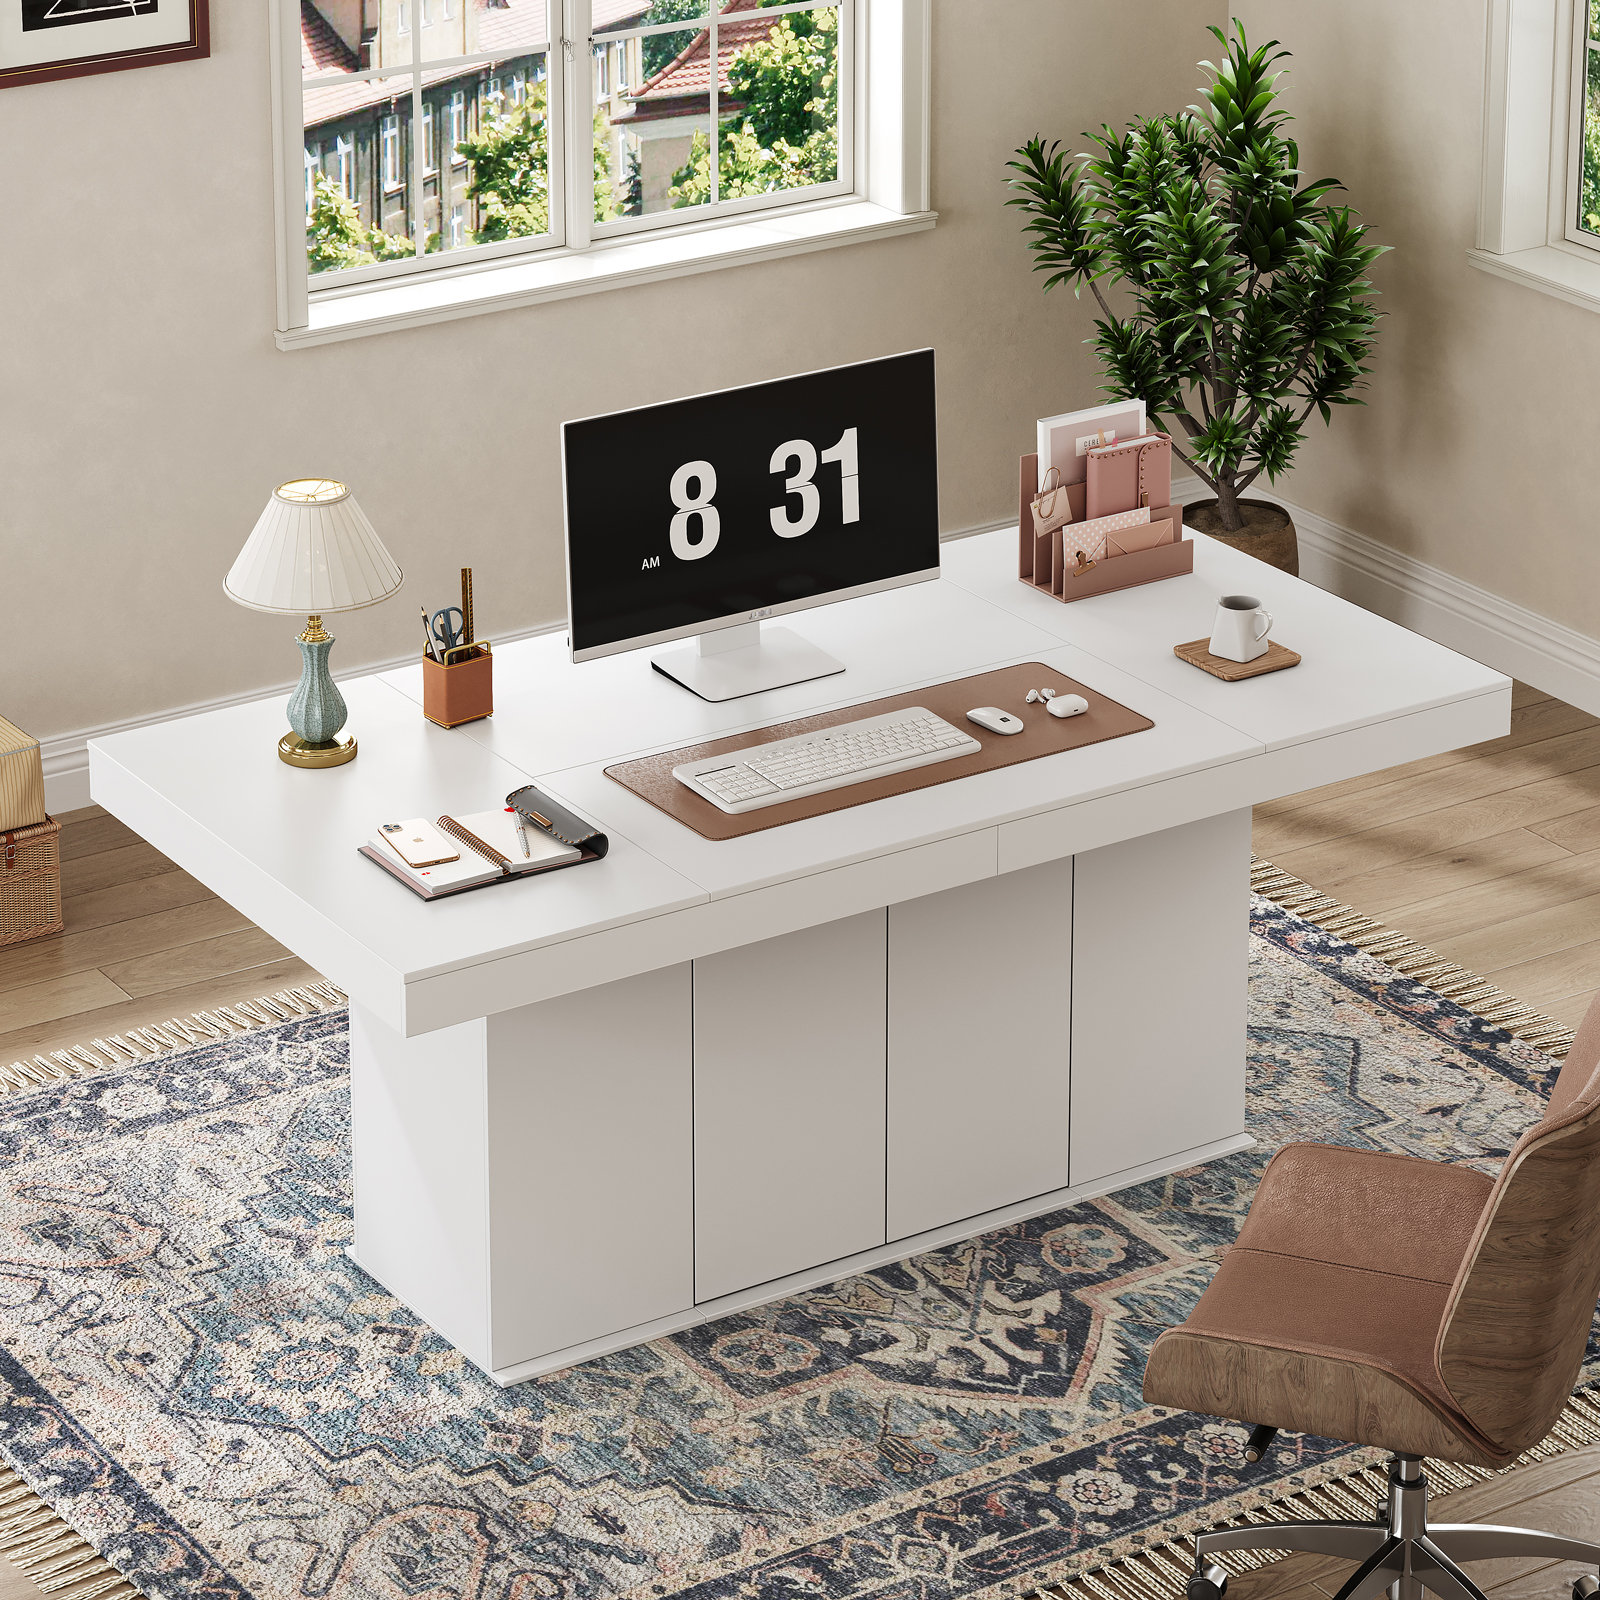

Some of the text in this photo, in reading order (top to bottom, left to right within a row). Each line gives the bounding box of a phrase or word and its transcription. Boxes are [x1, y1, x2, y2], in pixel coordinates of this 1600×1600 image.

[669, 427, 859, 561] 8 31
[641, 555, 660, 570] AM
